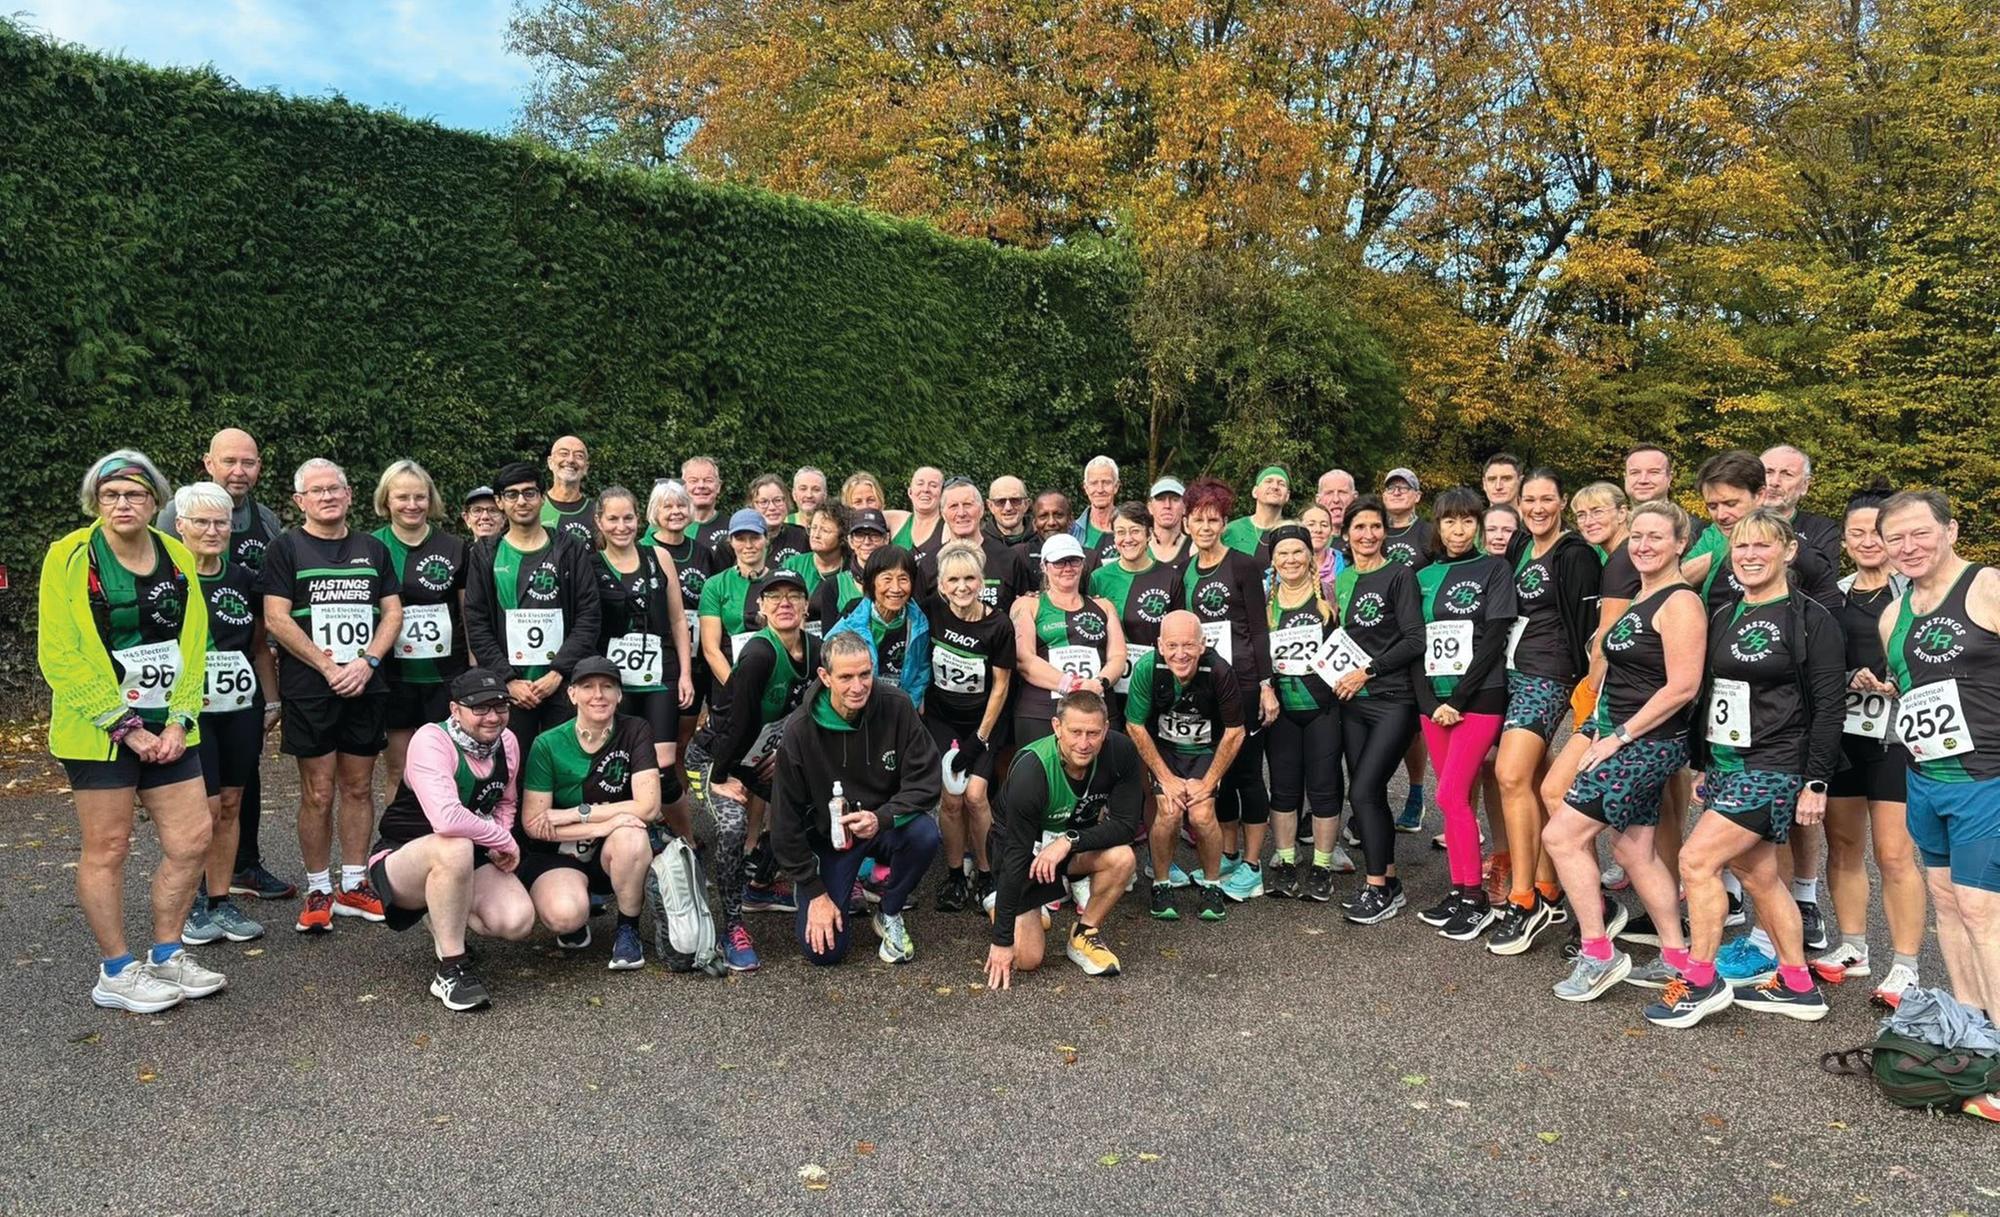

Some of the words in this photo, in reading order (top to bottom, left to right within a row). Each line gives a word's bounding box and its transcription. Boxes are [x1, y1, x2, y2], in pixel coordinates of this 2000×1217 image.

[416, 554, 455, 572] HASTINGS
[309, 579, 370, 592] HASTINGS
[1197, 581, 1231, 598] HASTINGS
[1446, 580, 1483, 597] HASTINGS
[310, 590, 371, 603] RUNNERS
[1137, 588, 1171, 604] HASTINGS
[1356, 592, 1385, 608] HASTINGS
[1137, 608, 1167, 623] RUNNE
[1198, 603, 1229, 617] RUNNERS
[1444, 601, 1481, 615] RUNNERS
[1286, 613, 1321, 628] HASTING
[1353, 613, 1385, 628] RUNNERS
[1914, 616, 1966, 640] HASTINGS
[319, 622, 370, 646] 109
[406, 621, 440, 642] 43
[527, 626, 544, 649] 9
[944, 628, 980, 648] TRACY
[1737, 621, 1780, 642] HASTINGS
[1917, 627, 1953, 651] HR
[1275, 641, 1318, 661] 223
[1325, 643, 1360, 672] 13
[1433, 637, 1460, 660] 69
[1913, 643, 1965, 663] RUNNERS
[611, 649, 658, 671] 267
[139, 664, 175, 689] 96
[938, 664, 980, 685] 124
[1062, 661, 1093, 680] 65
[203, 668, 252, 695] 156
[1715, 699, 1729, 725] 3
[1164, 716, 1207, 737] 167
[1899, 704, 1961, 743] 252
